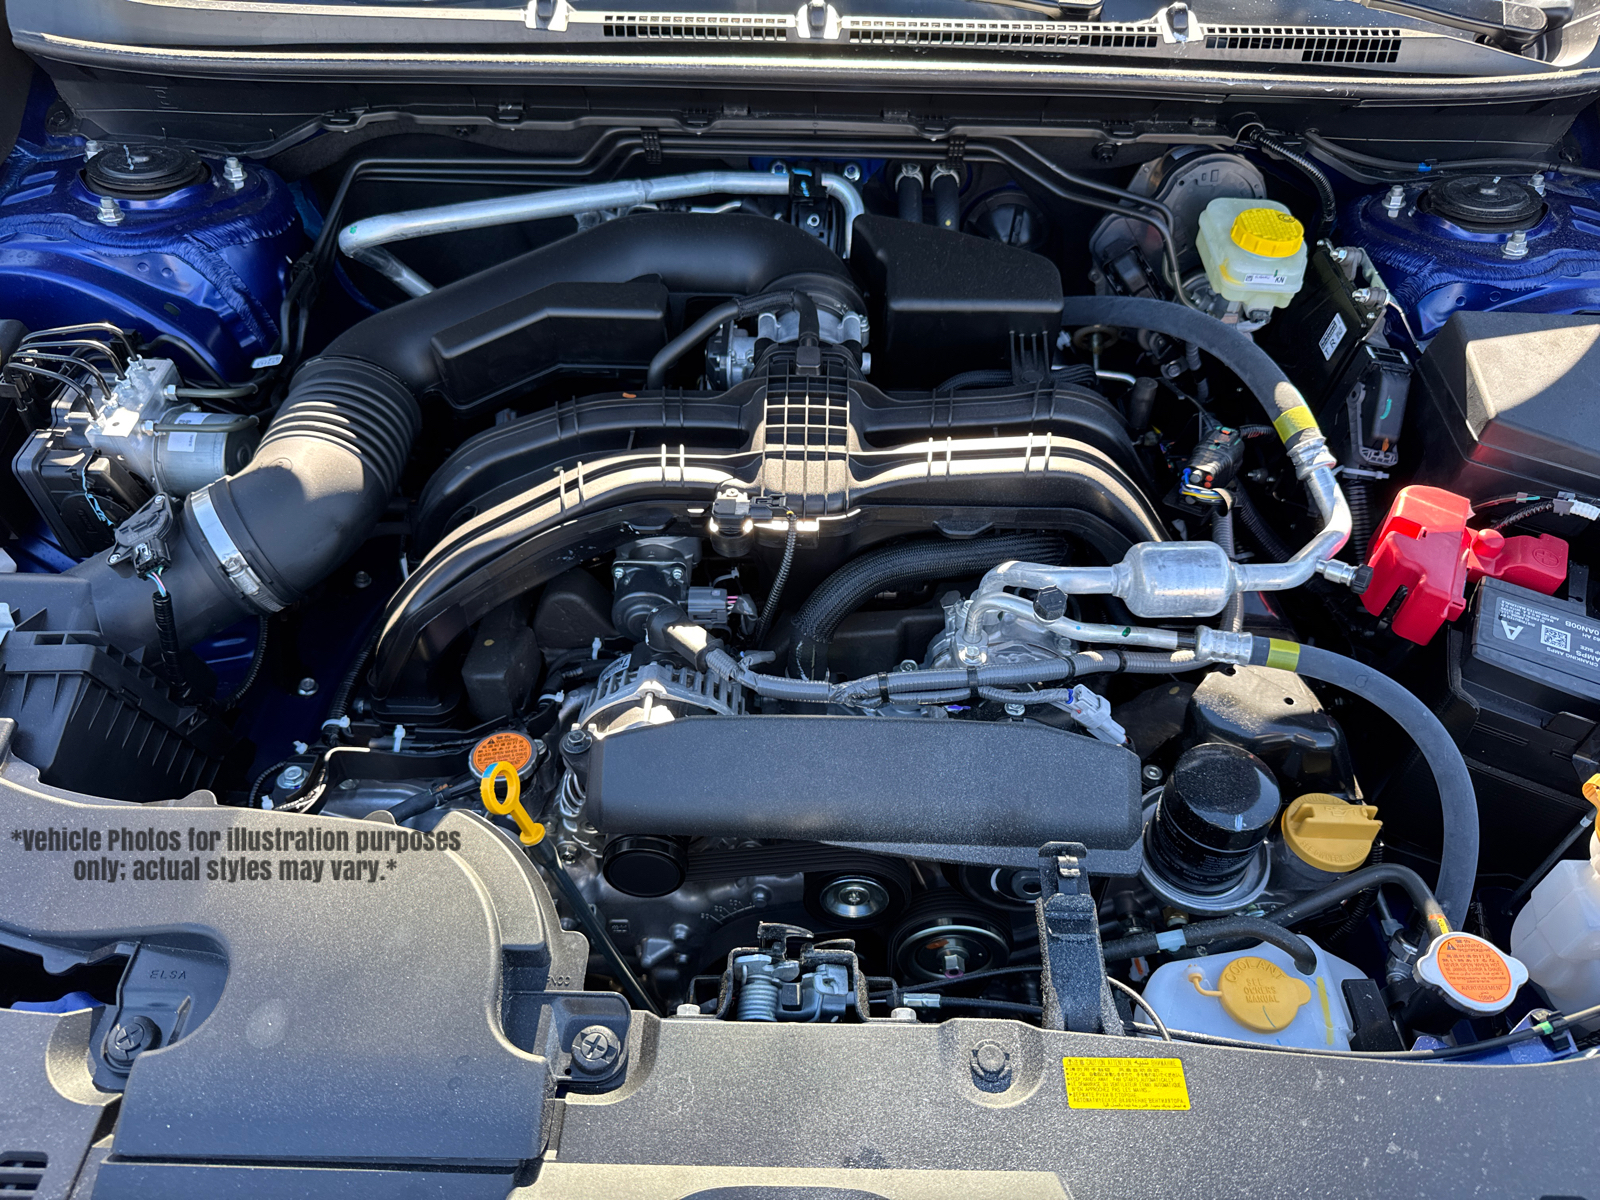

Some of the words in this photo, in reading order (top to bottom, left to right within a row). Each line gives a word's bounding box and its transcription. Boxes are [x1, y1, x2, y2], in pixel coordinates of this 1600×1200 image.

[1546, 646, 1564, 656] AMPS
[1580, 645, 1593, 653] SIZE
[1565, 653, 1598, 667] CRANKING
[1576, 650, 1600, 662] AMPS
[150, 970, 186, 979] ELSA
[1225, 958, 1286, 983] COOLANT
[1246, 978, 1263, 986] SEE
[1244, 986, 1276, 995] OWNERS
[1246, 995, 1280, 1003] MANUAL
